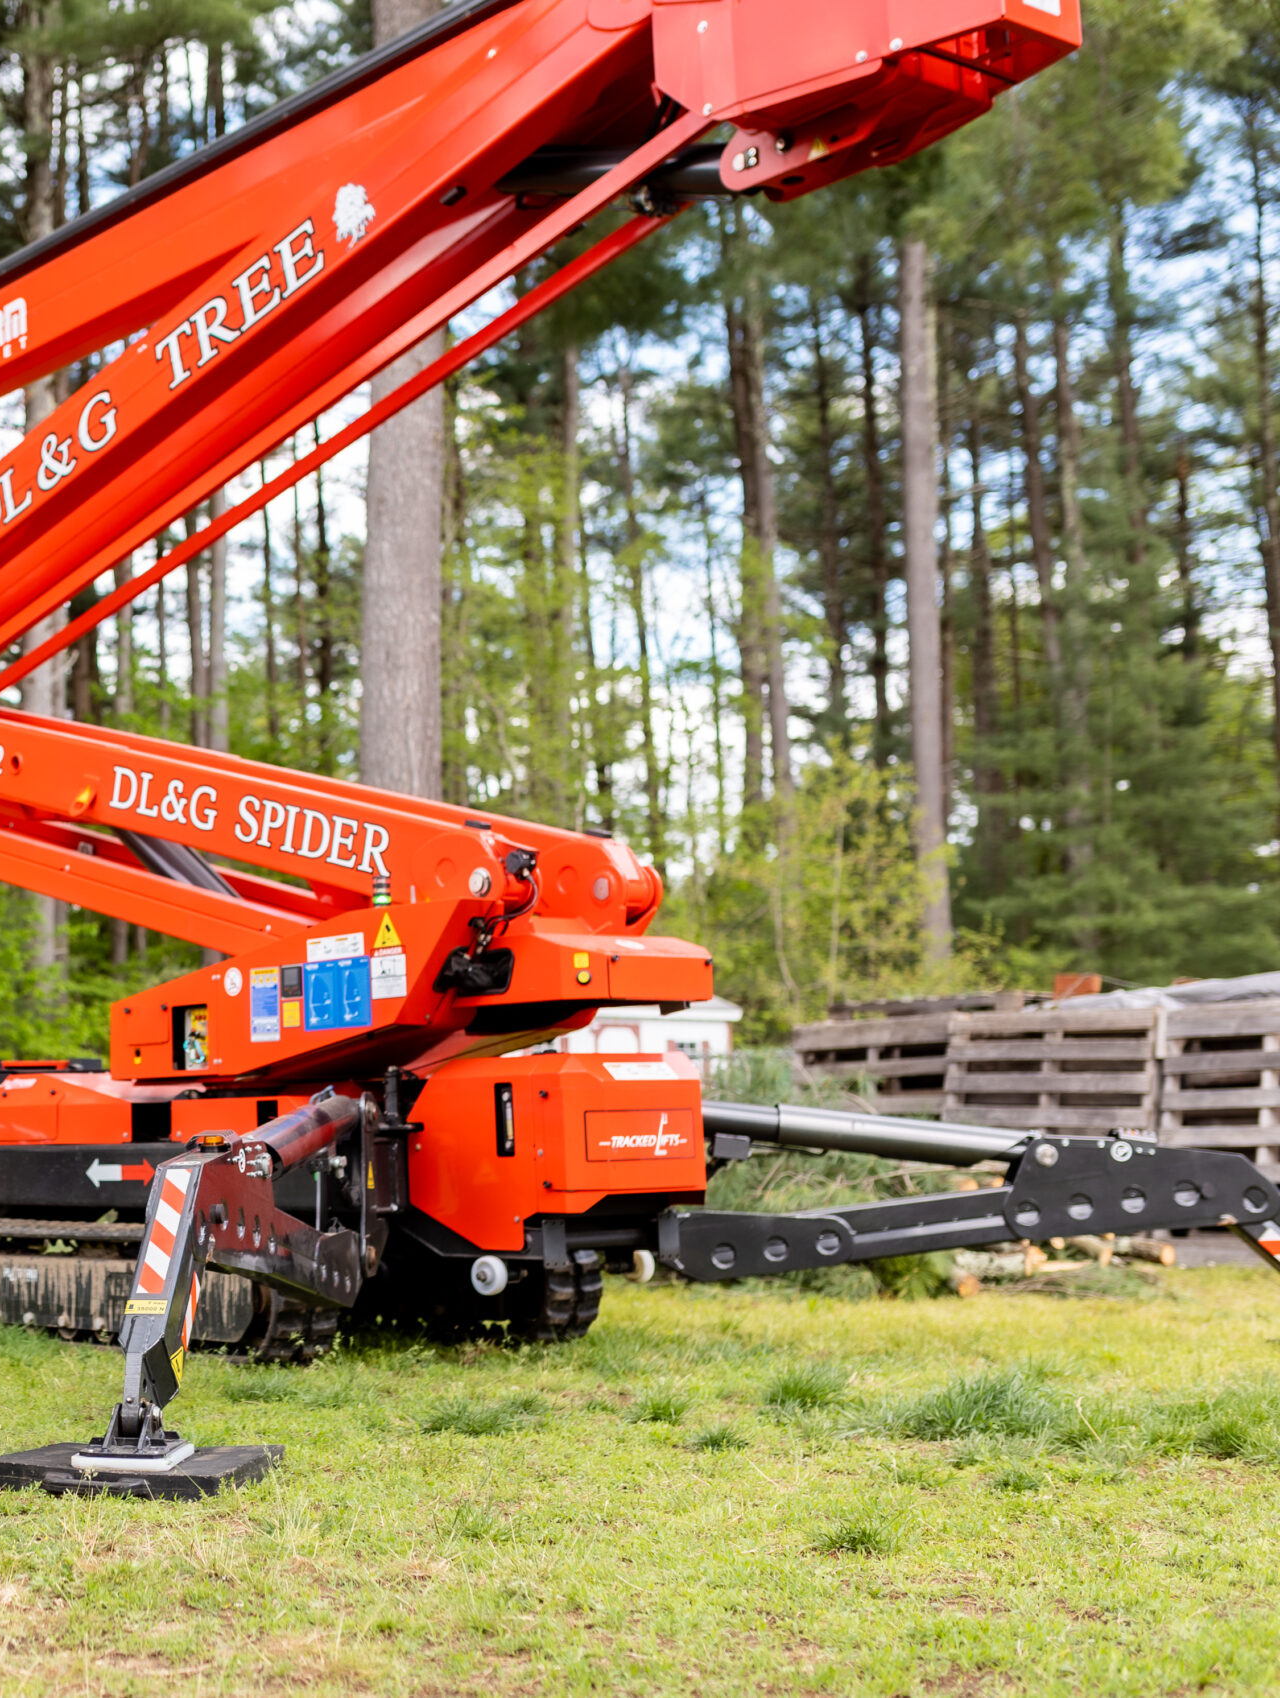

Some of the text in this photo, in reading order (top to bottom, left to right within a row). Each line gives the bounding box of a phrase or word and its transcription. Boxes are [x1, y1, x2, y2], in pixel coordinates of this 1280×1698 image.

[155, 216, 325, 391] TREE
[109, 765, 391, 877] DL&G SPIDER
